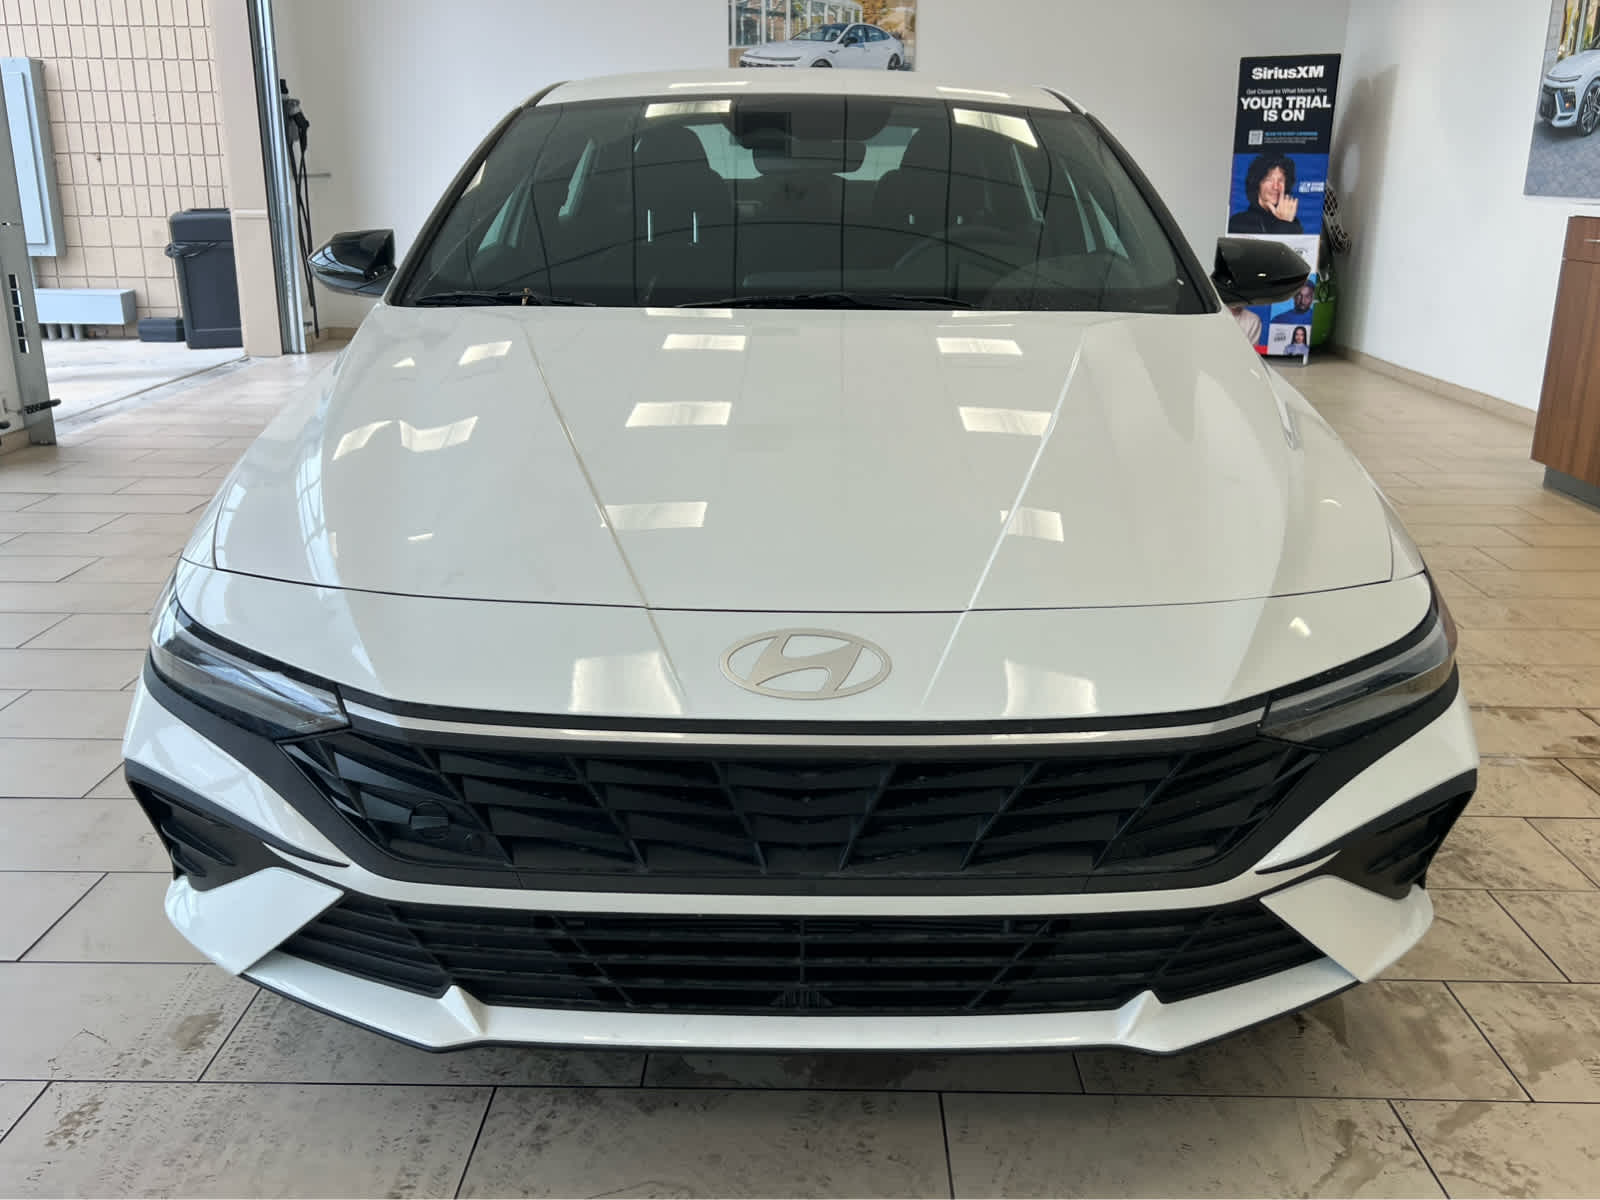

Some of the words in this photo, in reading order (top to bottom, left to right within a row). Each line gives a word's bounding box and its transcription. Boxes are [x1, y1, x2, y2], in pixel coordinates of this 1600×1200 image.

[1252, 65, 1324, 80] SiriusXM
[1240, 97, 1282, 110] YOUR
[1286, 95, 1331, 109] TRIAL
[1263, 110, 1278, 122] IS
[1281, 109, 1305, 121] ON
